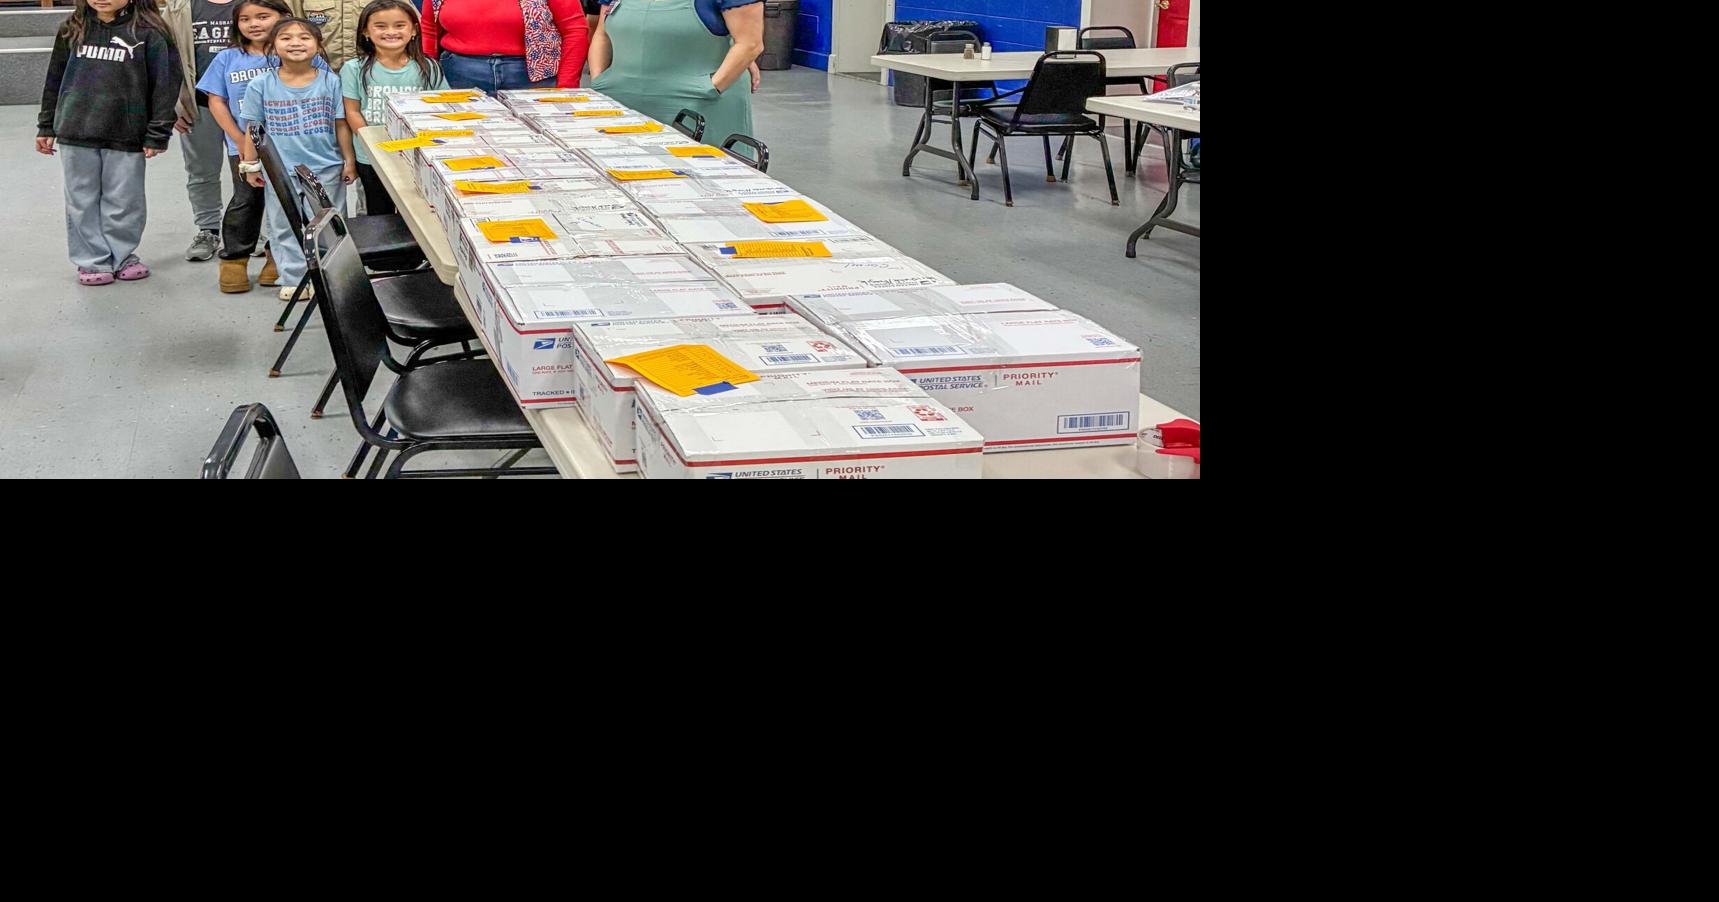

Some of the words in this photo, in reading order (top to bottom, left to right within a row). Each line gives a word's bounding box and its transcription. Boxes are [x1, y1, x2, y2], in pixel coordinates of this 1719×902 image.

[76, 45, 126, 62] PUMA
[919, 376, 952, 384] UNITED
[734, 470, 770, 478] UNITED
[770, 468, 803, 476] STATES
